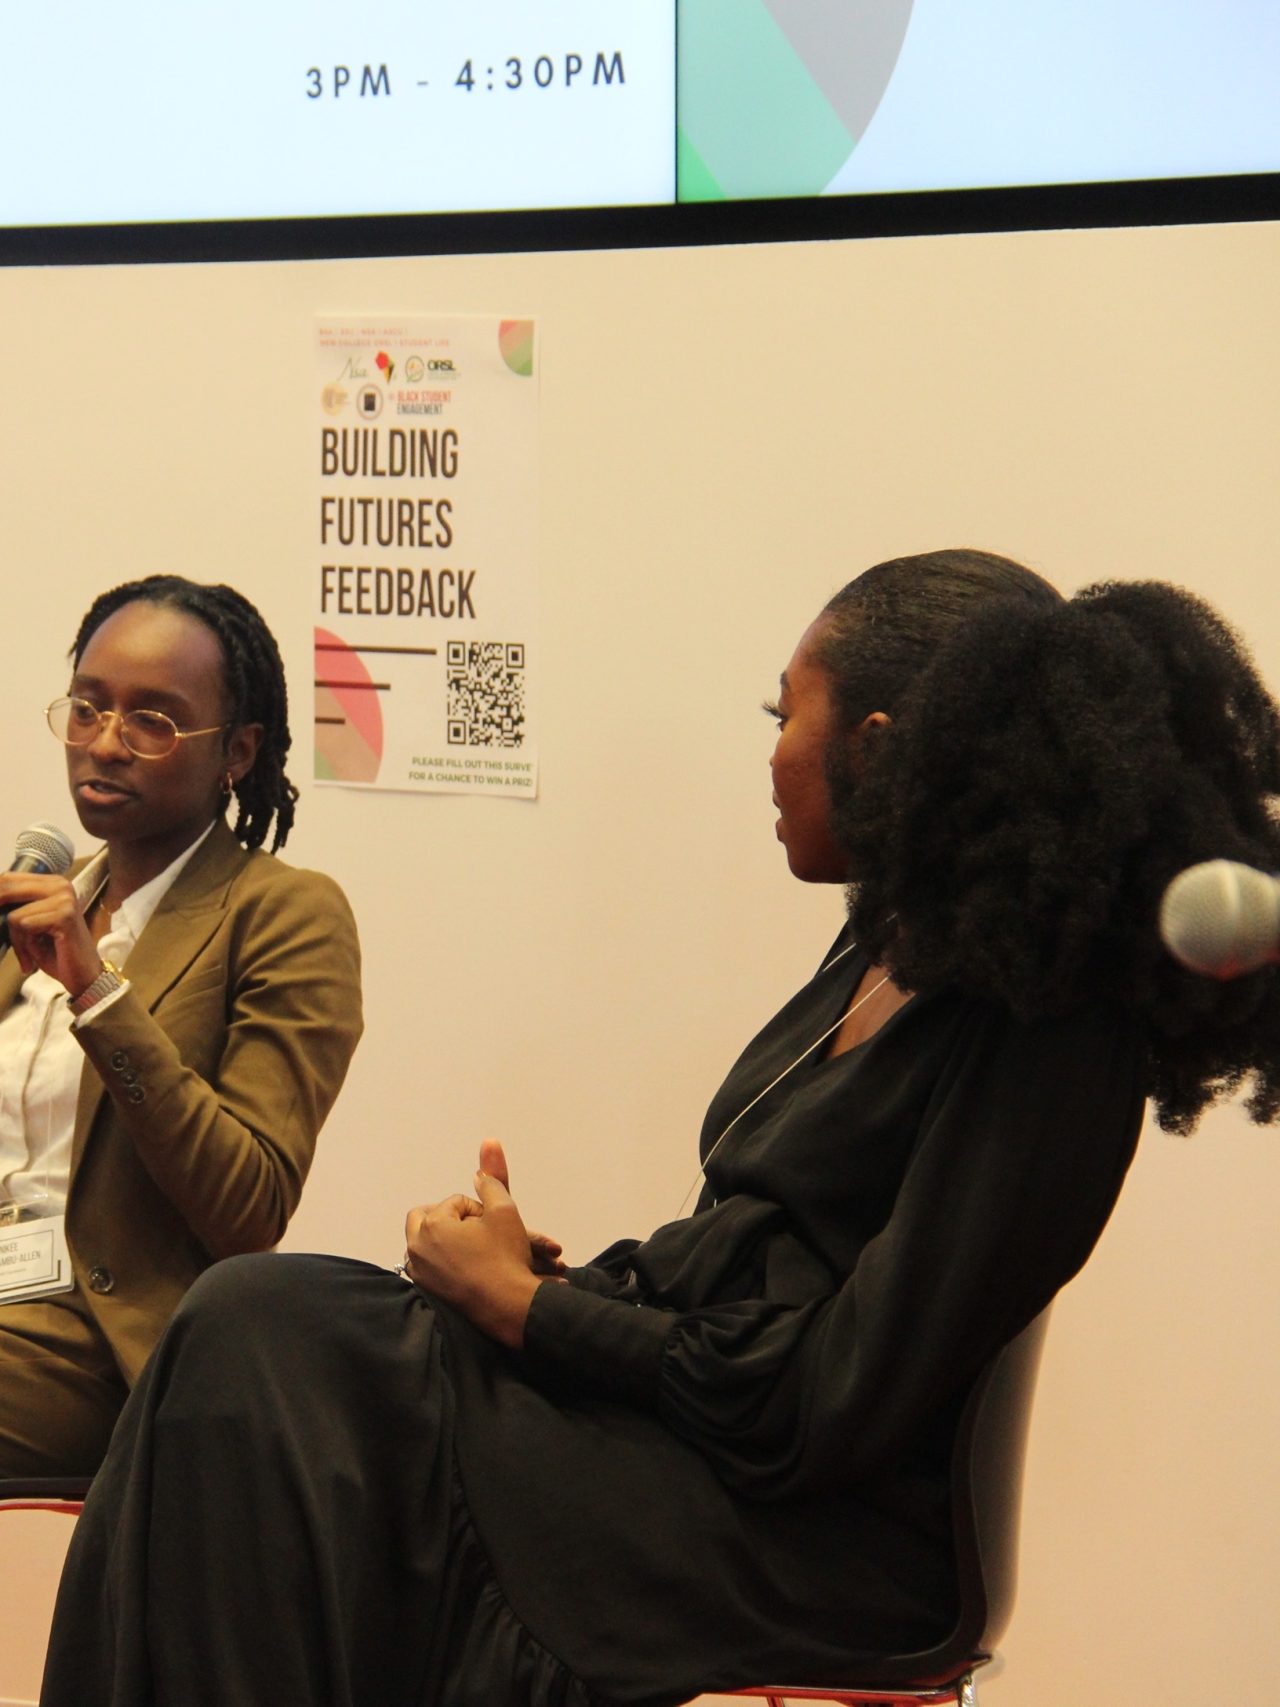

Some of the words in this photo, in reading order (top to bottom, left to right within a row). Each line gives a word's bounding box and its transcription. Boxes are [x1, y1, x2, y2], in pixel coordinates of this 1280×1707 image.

[305, 64, 391, 99] 3PM
[454, 50, 626, 92] 4:30PM
[427, 359, 456, 372] ORSL
[397, 390, 419, 402] BLACK
[421, 390, 452, 402] STUDENT
[397, 403, 443, 415] ENGAGEMENT
[321, 427, 459, 479] BUILDING
[321, 496, 453, 549] FUTURES
[321, 565, 477, 619] FEEDBACK
[412, 757, 444, 767] PLEASE
[446, 758, 463, 768] FILL
[464, 759, 482, 769] OUT
[483, 760, 503, 771] THIS
[504, 761, 533, 772] SURVE
[408, 771, 425, 780] FOR
[427, 772, 434, 781] A
[435, 773, 471, 784] CHANCE
[473, 775, 485, 784] TO
[486, 776, 503, 786] WIN
[504, 777, 512, 786] A
